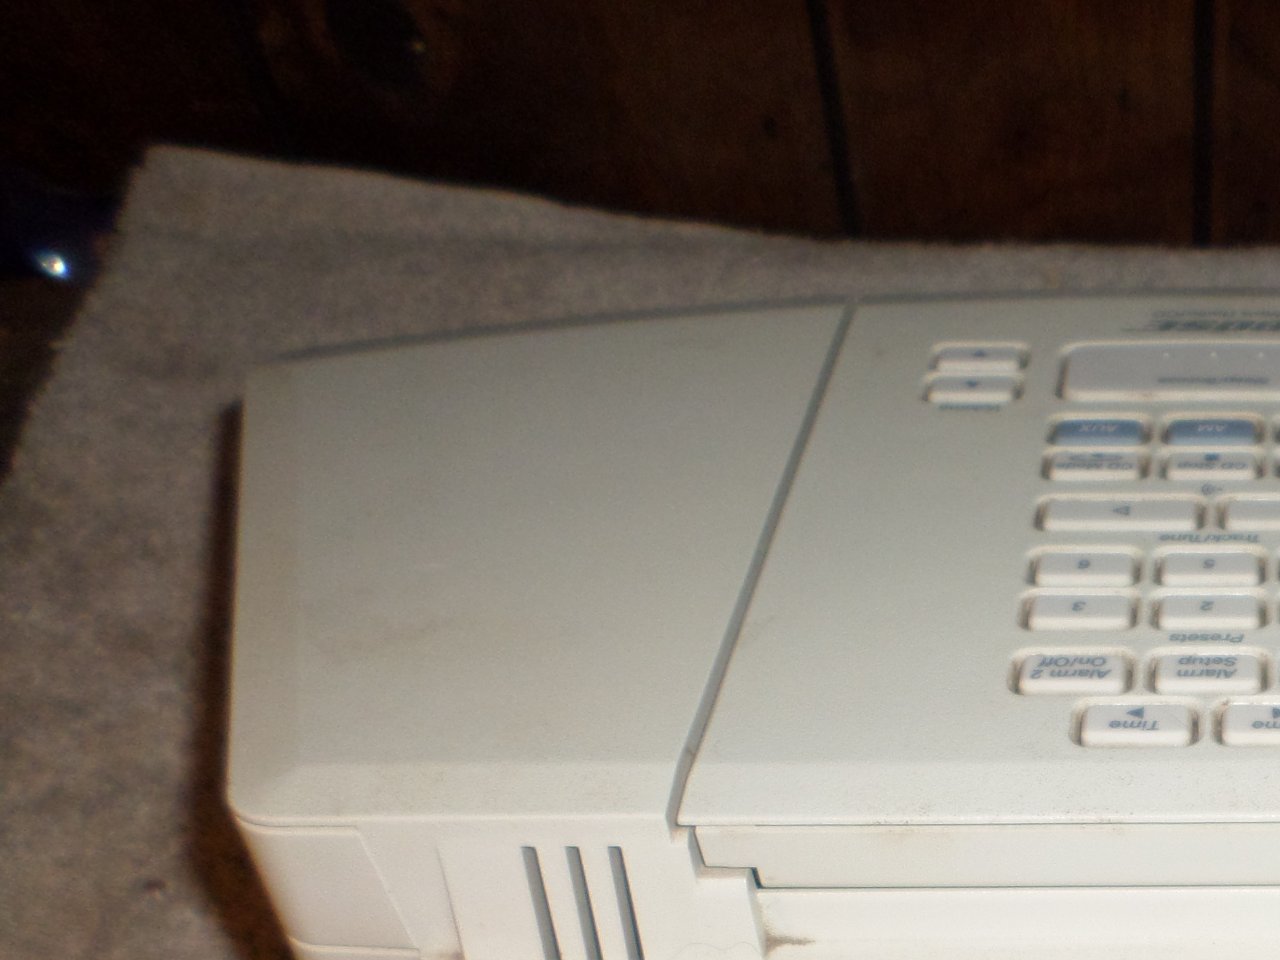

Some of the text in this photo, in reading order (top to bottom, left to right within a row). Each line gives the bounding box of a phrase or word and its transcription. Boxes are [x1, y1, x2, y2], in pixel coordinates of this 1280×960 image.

[1079, 424, 1118, 433] AUX
[1197, 424, 1228, 433] AM
[1159, 533, 1261, 543] Track/Tune
[1077, 559, 1091, 570] 6
[1203, 559, 1217, 570] 5
[1071, 601, 1087, 612] 3
[1199, 601, 1215, 612] 2
[1169, 633, 1246, 645] Presets
[1036, 655, 1108, 668] On/Off
[1178, 655, 1239, 668] Setup
[1030, 668, 1113, 681] Alarm 2
[1177, 668, 1239, 681] Alarm
[1108, 720, 1160, 732] Time
